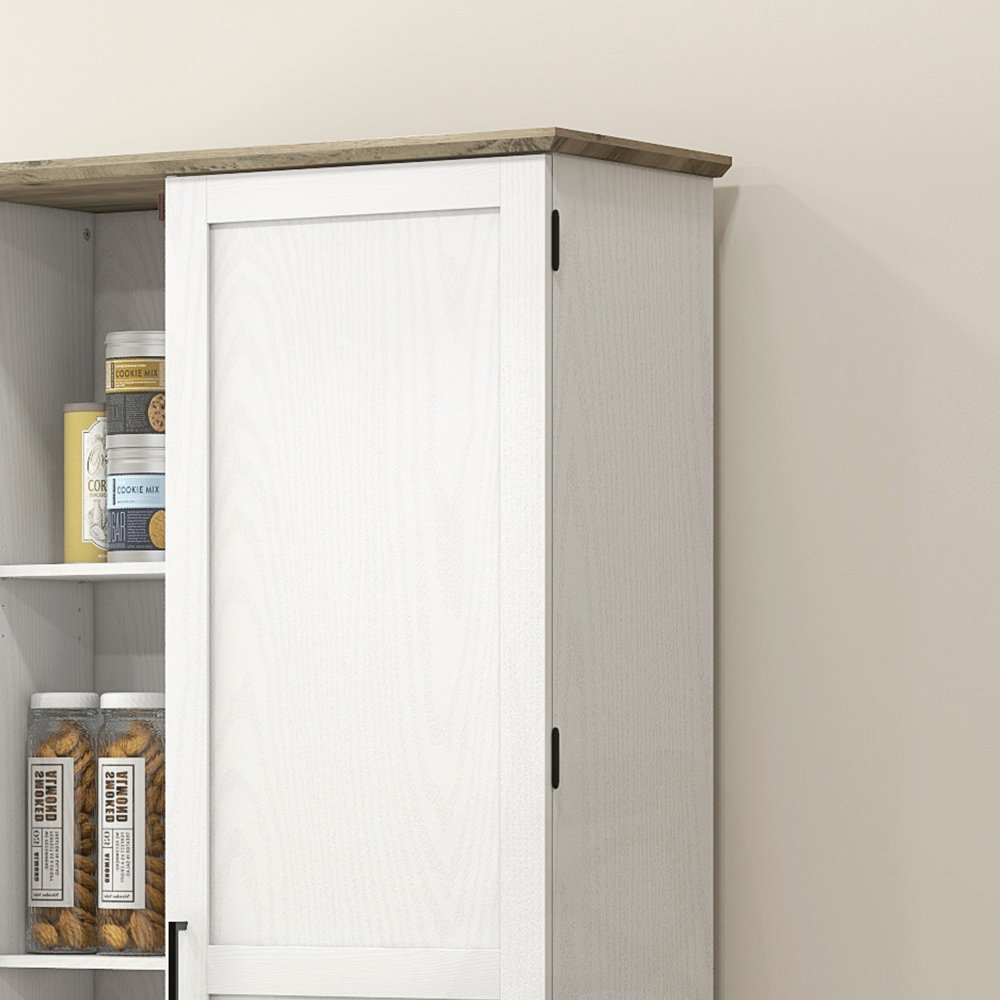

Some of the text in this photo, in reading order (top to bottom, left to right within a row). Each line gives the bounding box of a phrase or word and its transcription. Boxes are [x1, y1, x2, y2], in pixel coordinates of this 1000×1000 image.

[115, 369, 158, 378] COOKIE MIX
[117, 485, 160, 494] COOKIE MIX
